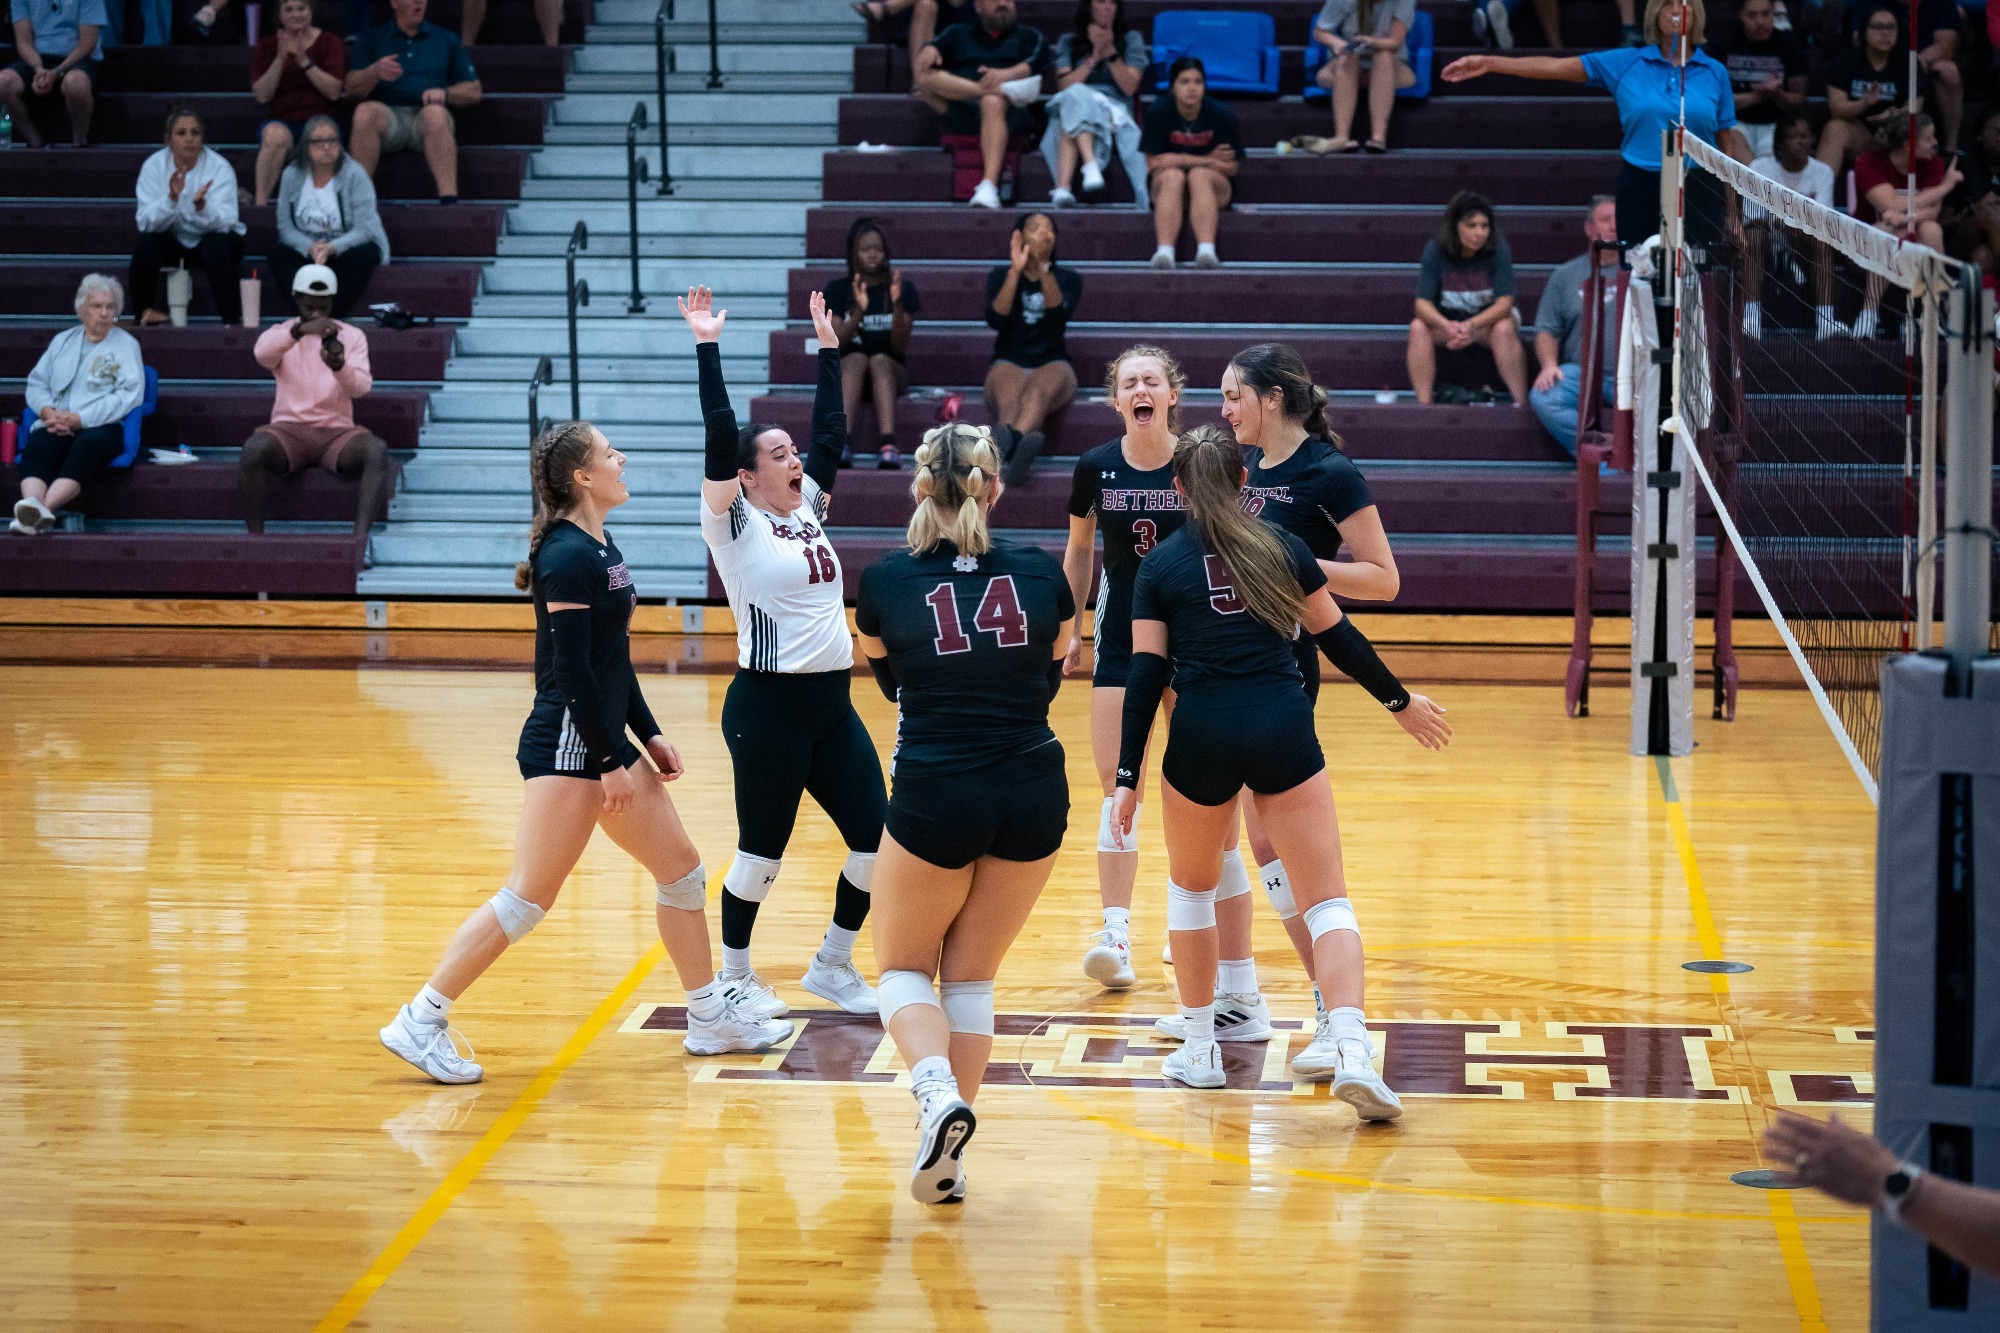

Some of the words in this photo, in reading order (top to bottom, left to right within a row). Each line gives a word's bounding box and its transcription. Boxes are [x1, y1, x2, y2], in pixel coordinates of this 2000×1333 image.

[1132, 519, 1157, 558] 3
[803, 544, 836, 584] 16
[1203, 554, 1247, 615] 5
[925, 575, 1028, 656] 14
